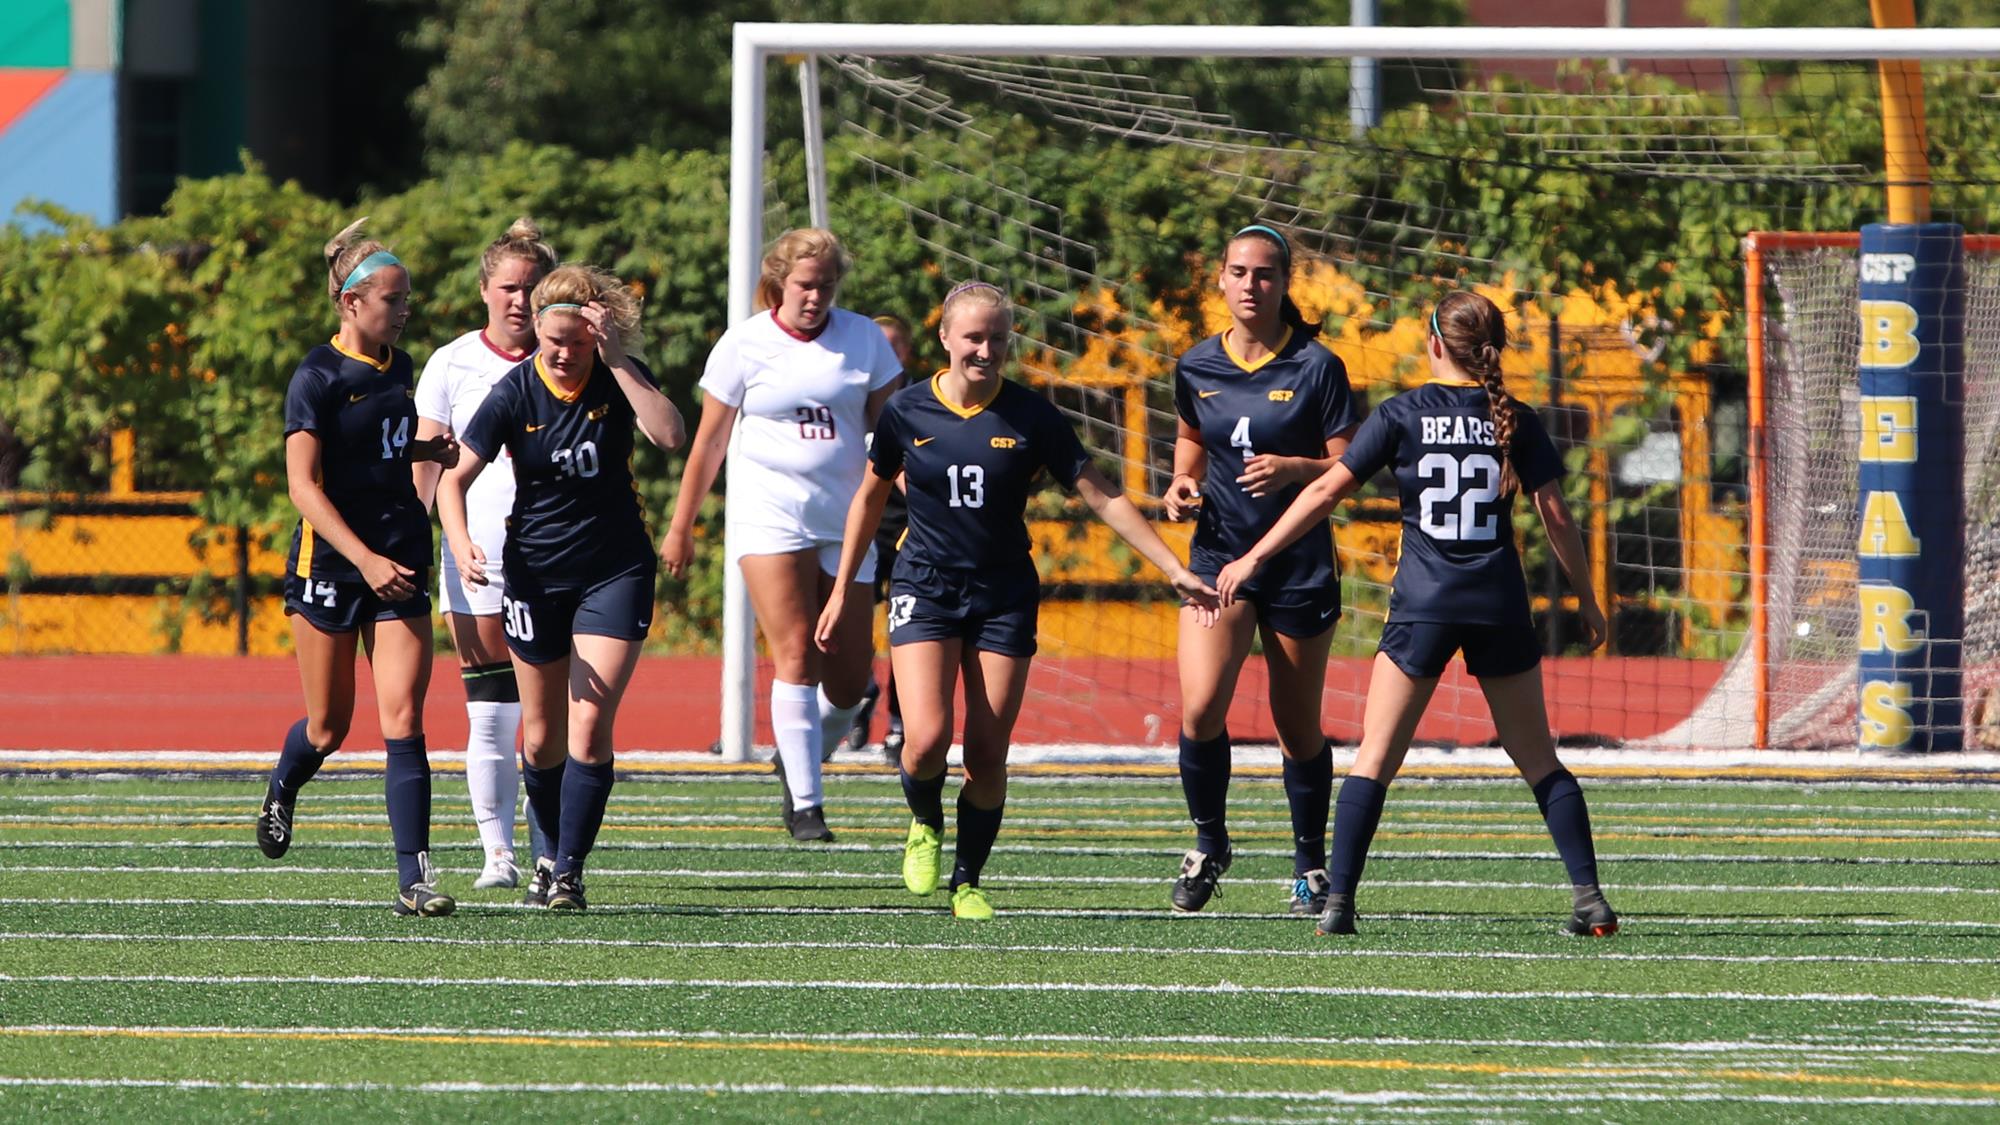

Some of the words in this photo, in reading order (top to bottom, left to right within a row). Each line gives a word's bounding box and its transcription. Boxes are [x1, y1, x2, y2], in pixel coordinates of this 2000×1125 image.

[1861, 253, 1916, 283] CSP
[382, 416, 409, 459] 14
[796, 405, 836, 440] 29
[990, 437, 1016, 449] CSP
[1230, 416, 1255, 457] 4
[1421, 416, 1497, 446] BEARS
[551, 440, 599, 480] 30
[946, 464, 984, 508] 13
[1418, 453, 1501, 540] 22
[1859, 300, 1921, 747] BEARS
[503, 595, 534, 642] 30
